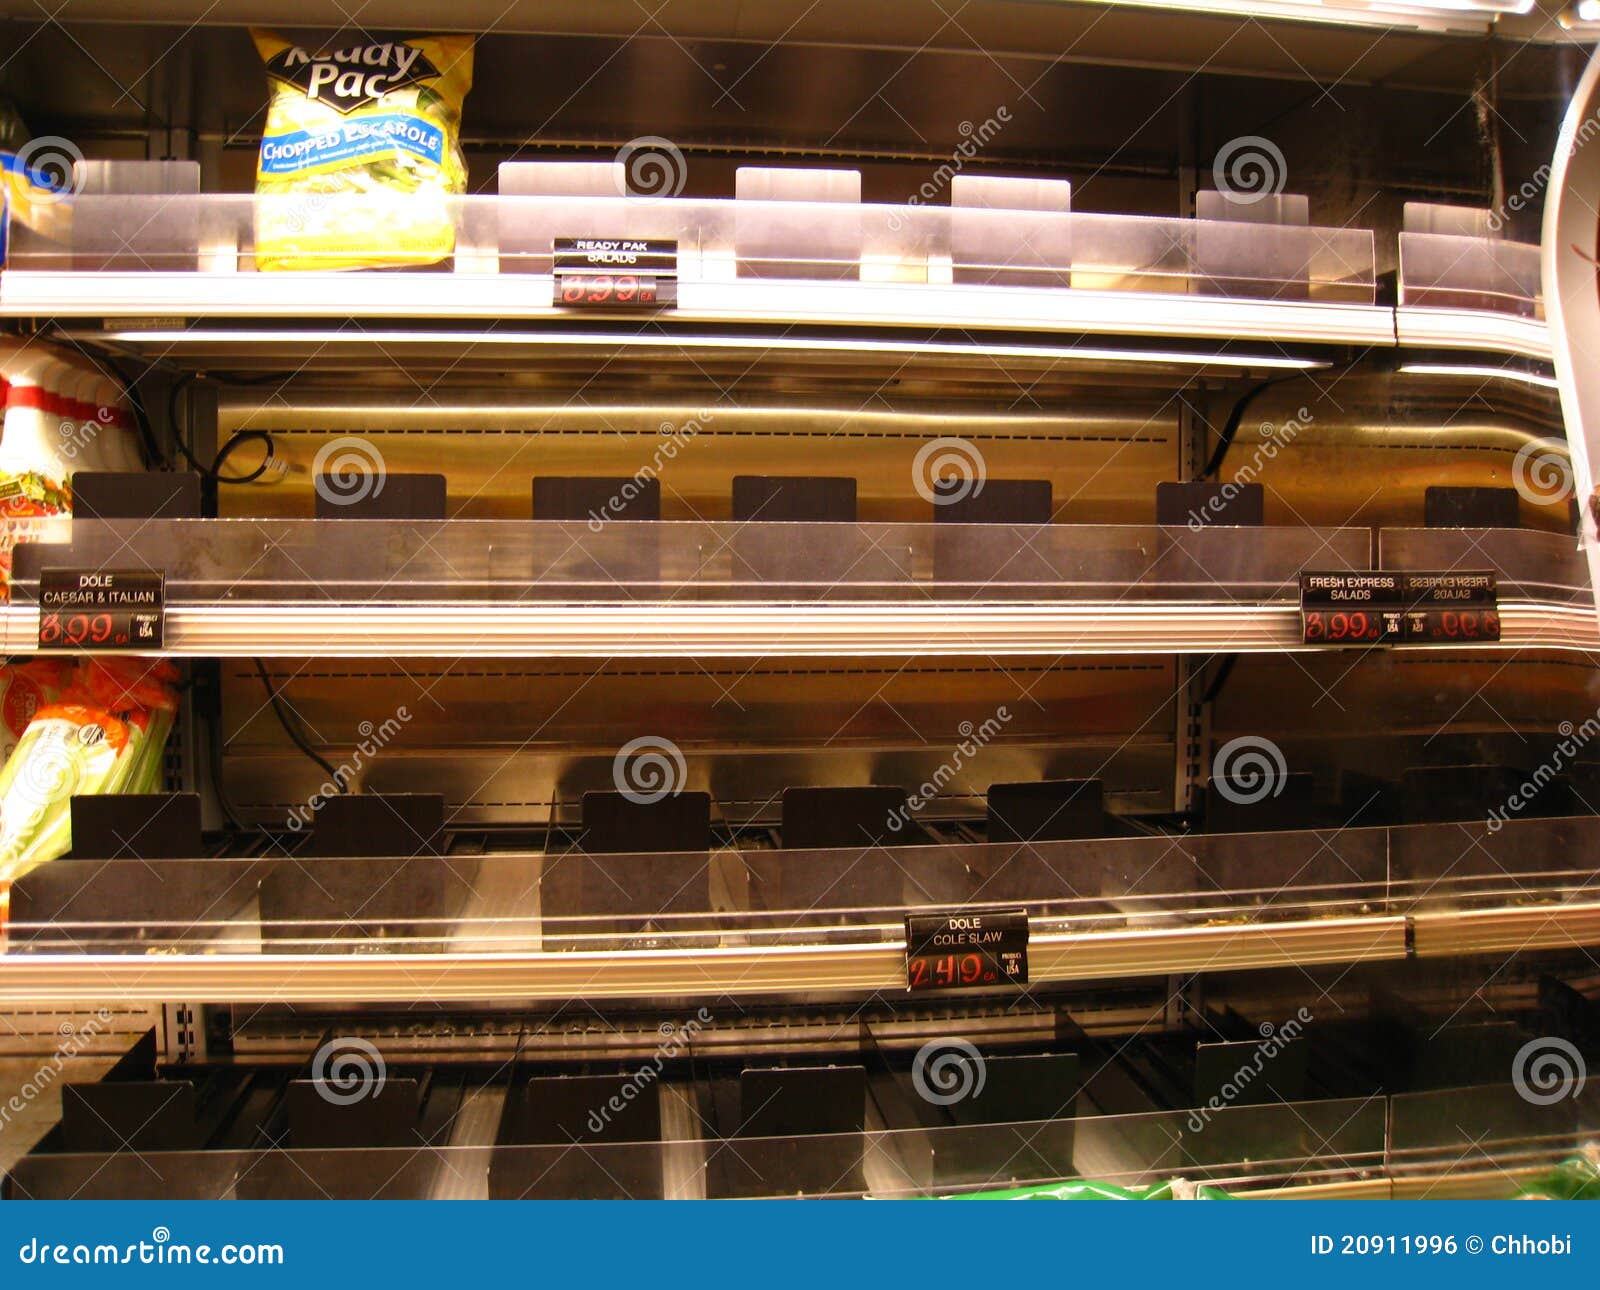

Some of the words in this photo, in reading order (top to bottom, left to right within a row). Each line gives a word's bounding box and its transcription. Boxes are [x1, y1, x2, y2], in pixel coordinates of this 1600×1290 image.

[307, 63, 386, 99] Pac
[576, 241, 620, 250] READY
[622, 242, 648, 251] PAK
[587, 253, 637, 264] SALADS
[79, 575, 113, 588] DOLE
[1309, 576, 1344, 588] FRESH
[1347, 577, 1395, 589] EXPRESS
[43, 591, 94, 603] CAESAR
[97, 591, 105, 603] &
[109, 591, 155, 603] ITALIAN
[1330, 589, 1371, 600] SALADS
[139, 627, 153, 637] USA
[949, 917, 982, 930] DOLE
[933, 933, 966, 946] COLE
[968, 931, 1002, 944] SLAW
[1006, 964, 1020, 975] USA
